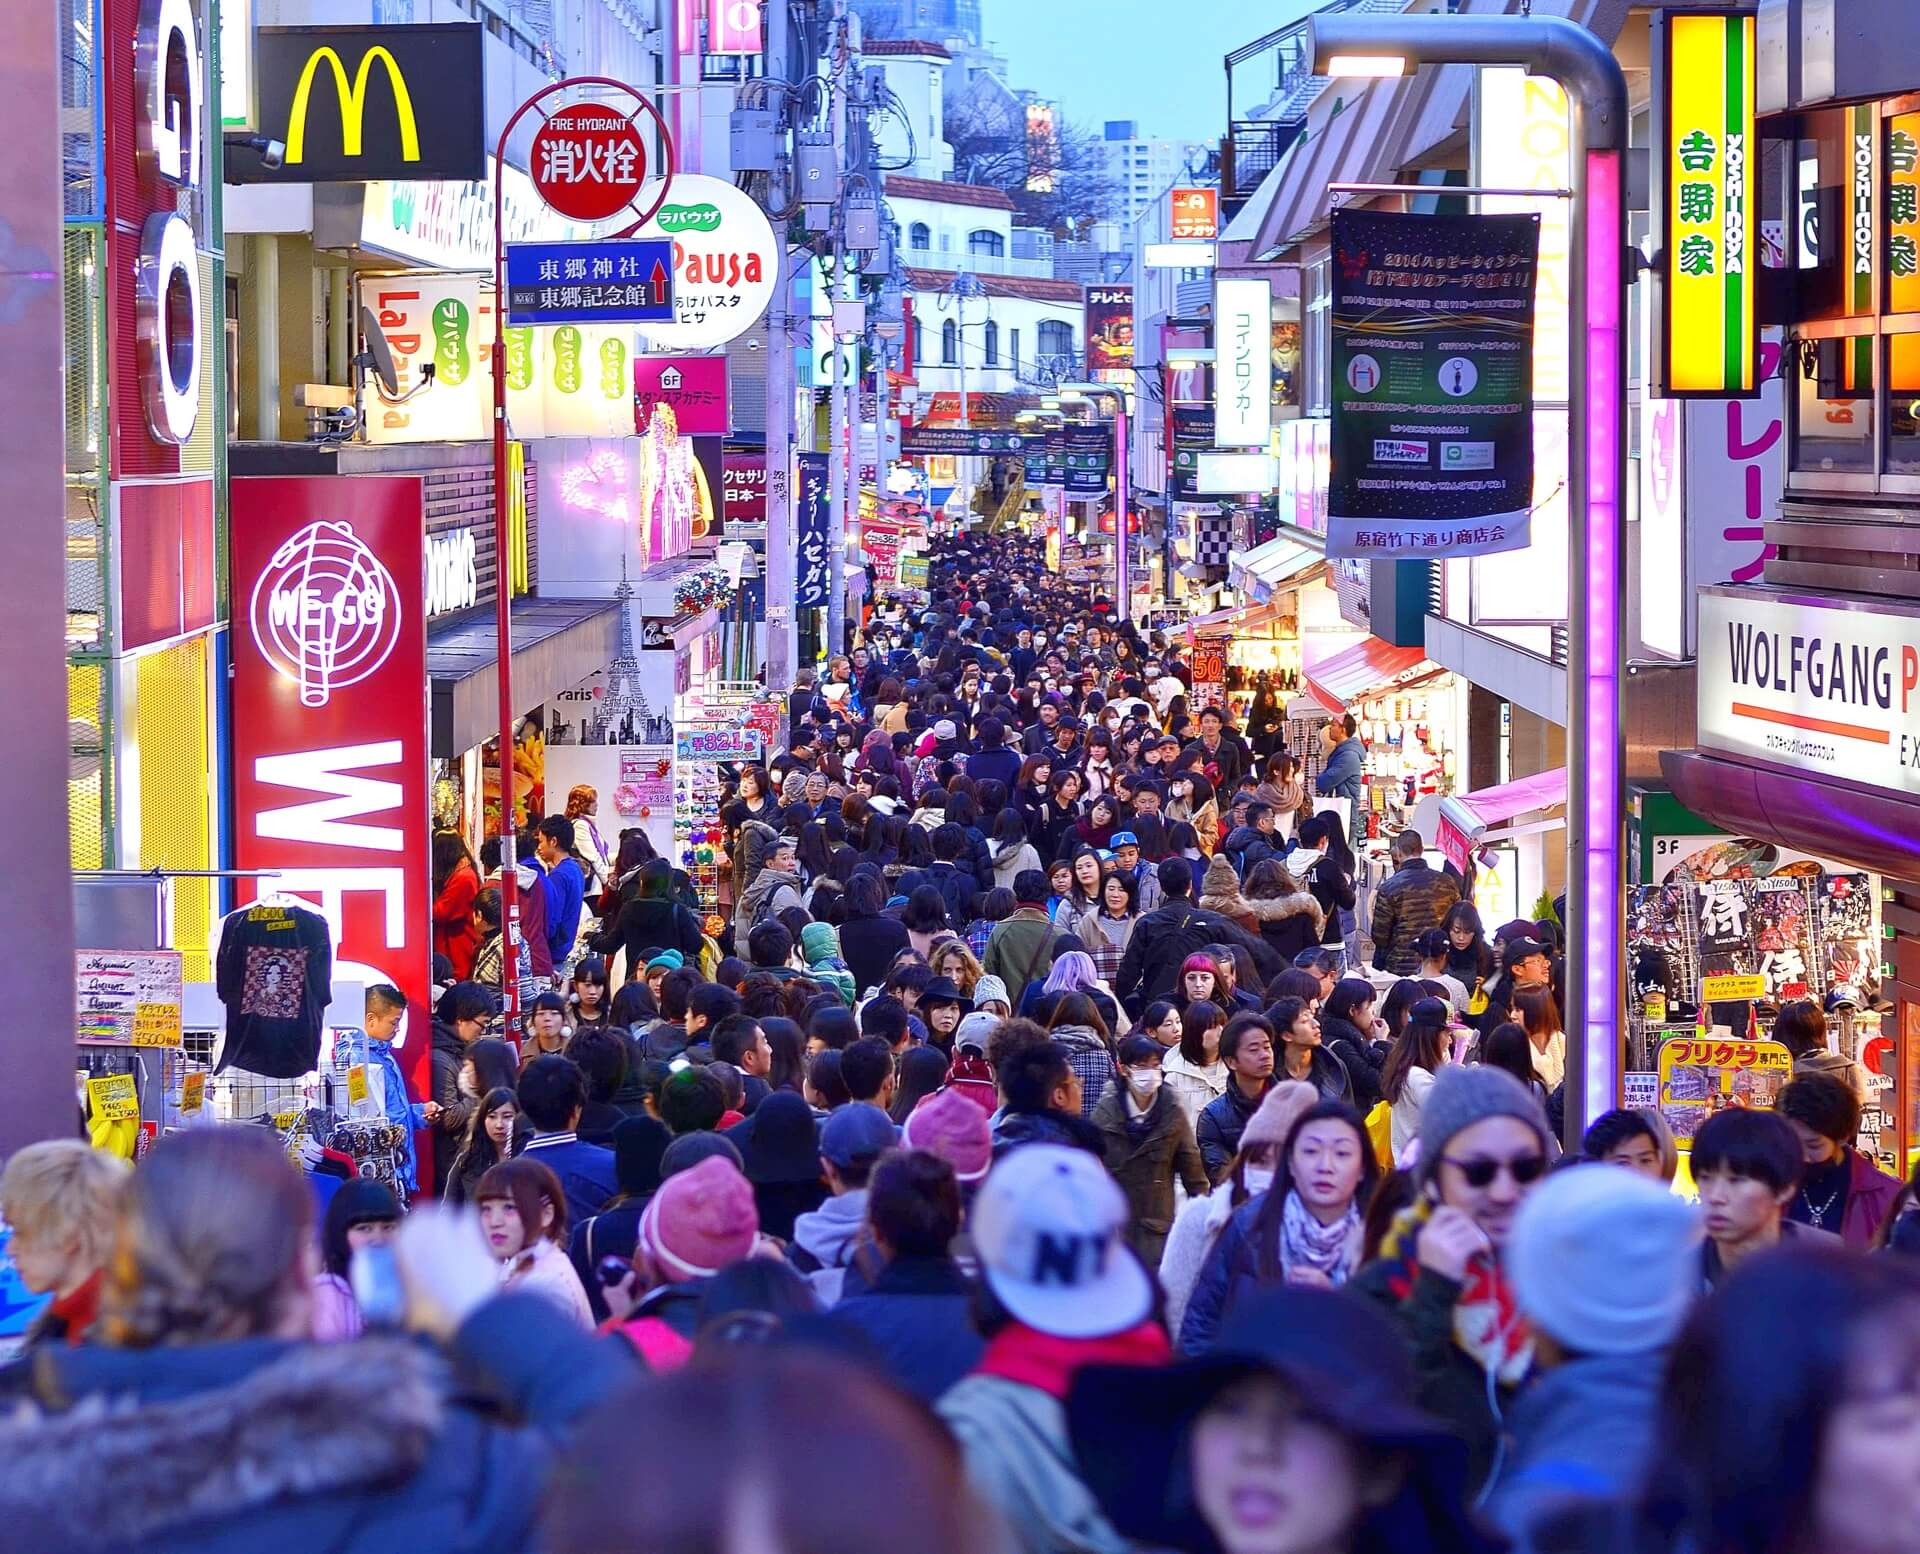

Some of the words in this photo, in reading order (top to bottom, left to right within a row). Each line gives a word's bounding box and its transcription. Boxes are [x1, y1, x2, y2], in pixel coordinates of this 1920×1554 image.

[549, 118, 574, 131] FIRE
[577, 118, 628, 132] HYDRANT
[541, 139, 638, 184] 消火栓
[1679, 130, 1717, 276] 吉野家
[1726, 134, 1743, 273] YOSHINOYA
[538, 257, 641, 281] 東郷神社
[539, 285, 646, 309] 東郷記念館
[379, 291, 420, 328] La
[442, 302, 461, 381] ラパウザ
[664, 375, 679, 386] 6F
[1236, 313, 1251, 425] コインロッカー
[725, 489, 768, 502] 日本一
[807, 476, 822, 527] ギャラリー
[1355, 525, 1505, 548] 原宿竹下通り商店会
[800, 530, 826, 605] ハセガワ
[1194, 656, 1221, 678] 50
[1728, 621, 1892, 710] WOLFGANG
[692, 732, 743, 751] ¥324
[1657, 840, 1679, 855] 3F
[1700, 894, 1748, 937] 侍
[1671, 1042, 1758, 1066] プリクラ
[1759, 1052, 1788, 1065] 専門店
[1867, 1076, 1892, 1087] JAPA
